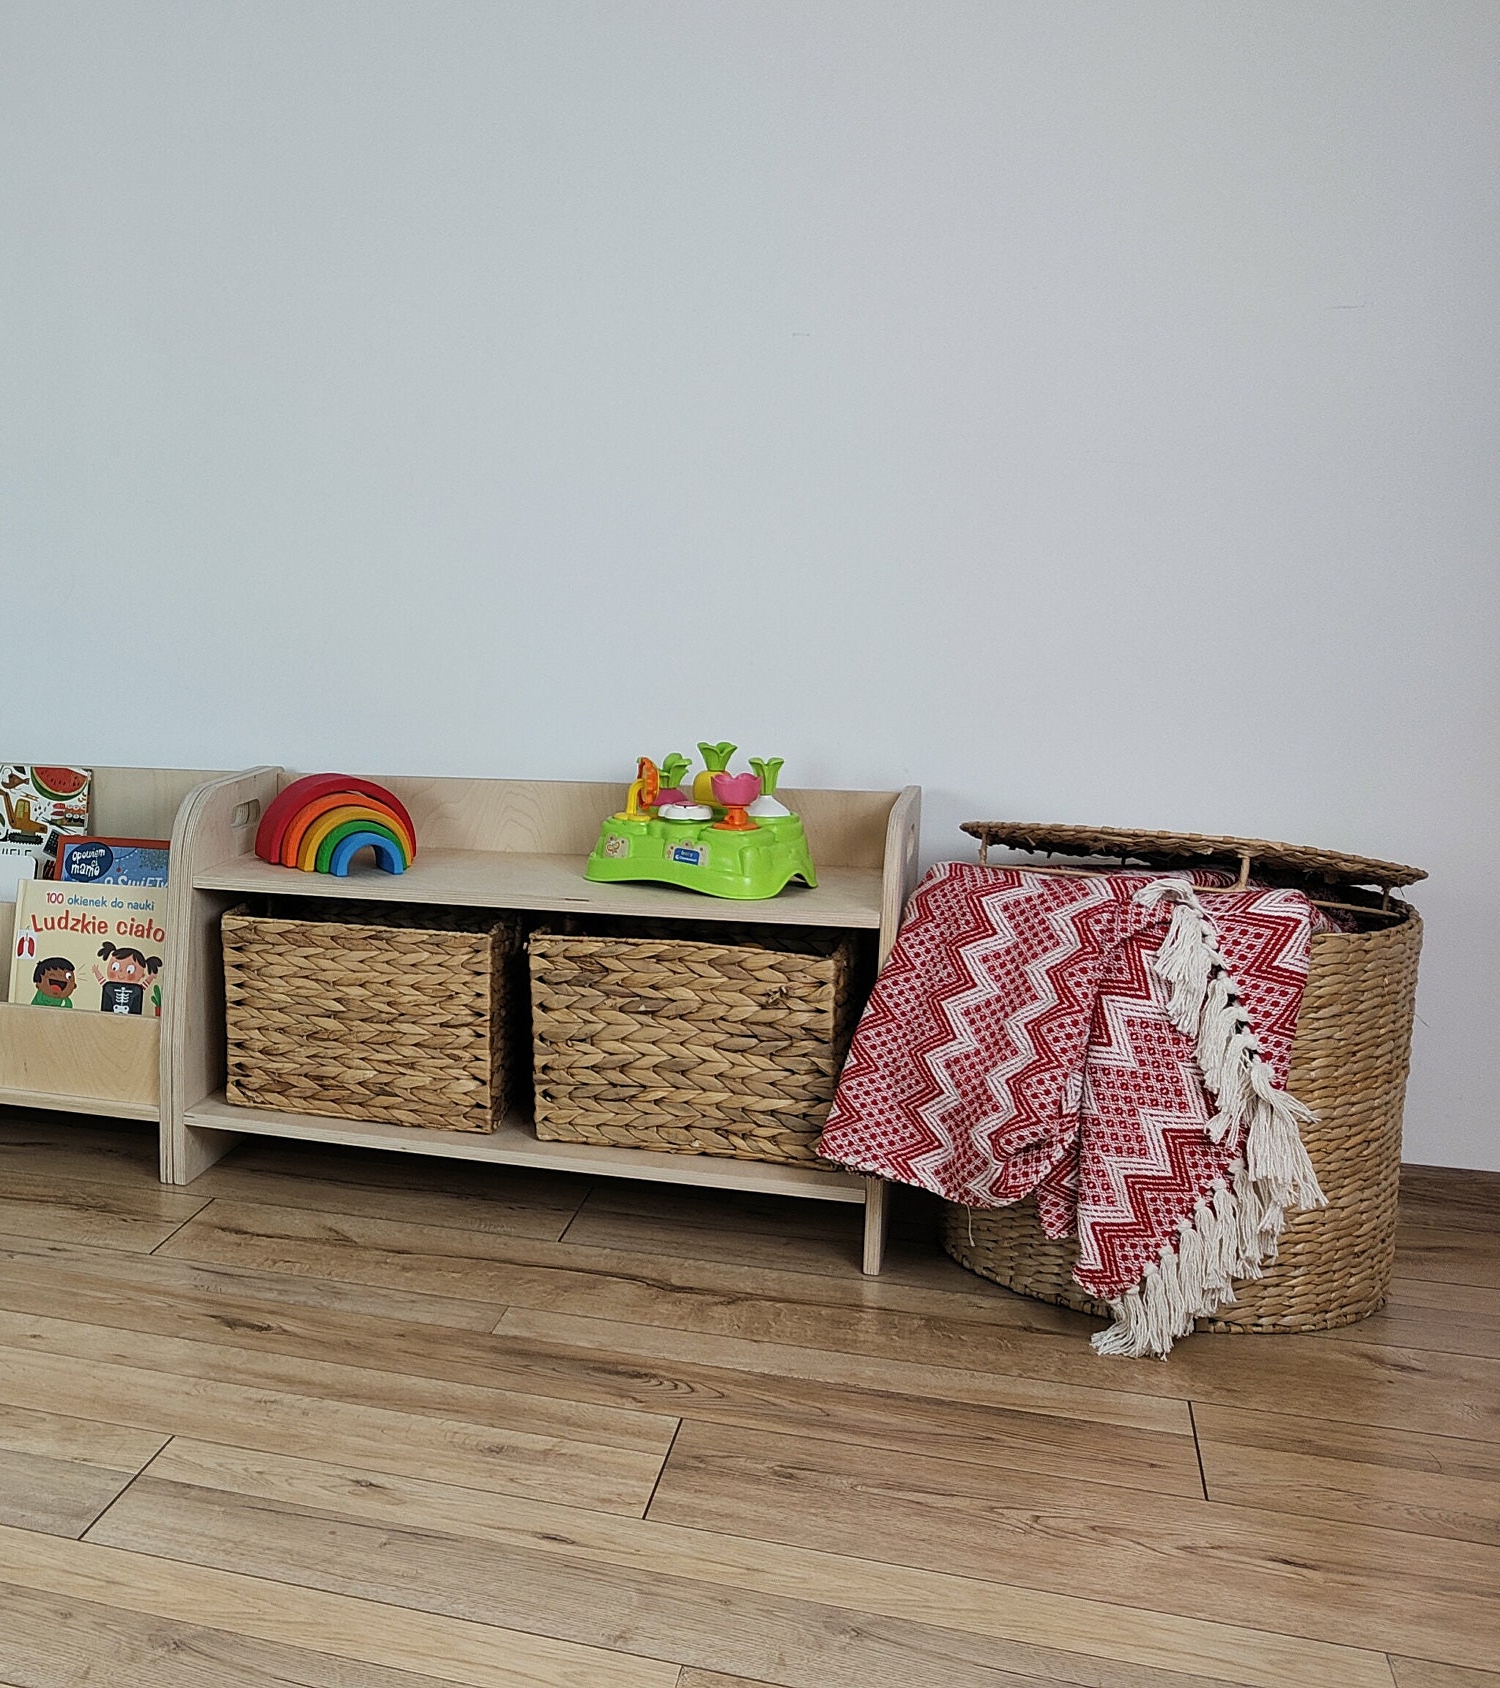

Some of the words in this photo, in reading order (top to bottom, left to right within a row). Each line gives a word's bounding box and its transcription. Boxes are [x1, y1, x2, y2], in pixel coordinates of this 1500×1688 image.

[72, 848, 106, 864] opowiem
[71, 863, 100, 877] mamo
[46, 892, 65, 905] 100
[67, 894, 108, 907] okienek
[111, 897, 124, 908] do
[127, 900, 155, 911] nauki
[31, 909, 109, 935] Ludzkie
[116, 917, 166, 943] ciało
